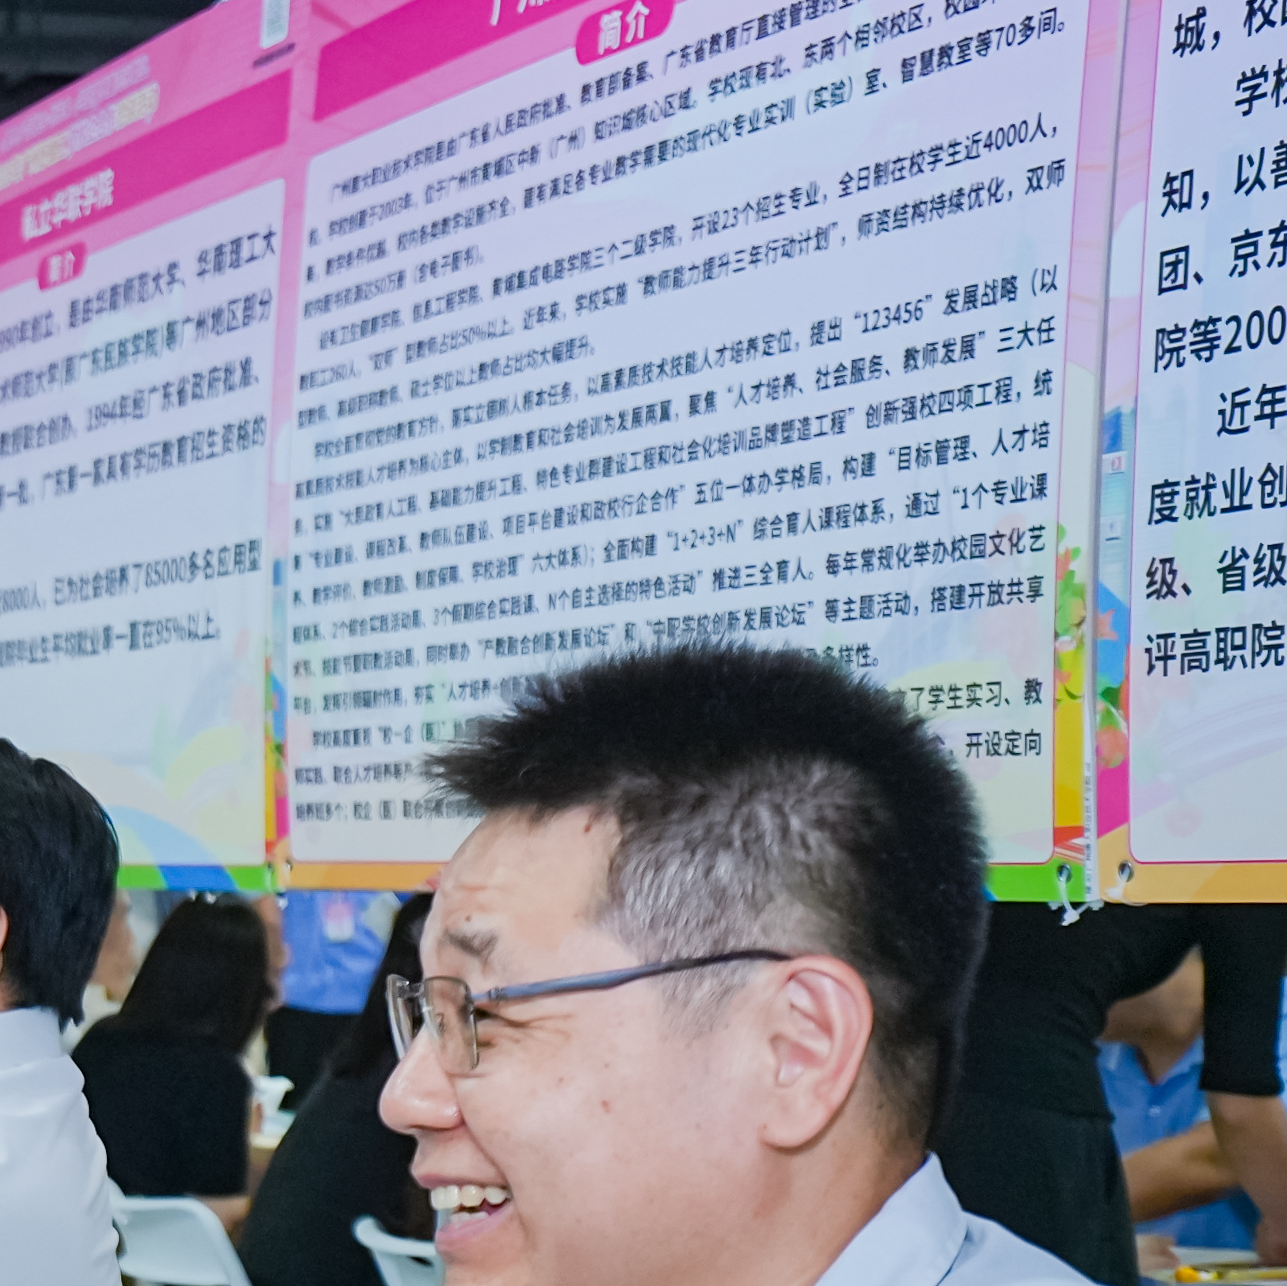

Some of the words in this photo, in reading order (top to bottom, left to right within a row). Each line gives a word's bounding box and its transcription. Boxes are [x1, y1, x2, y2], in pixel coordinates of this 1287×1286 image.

[597, 0, 650, 57] 简介
[1145, 620, 1287, 676] 评高职院
